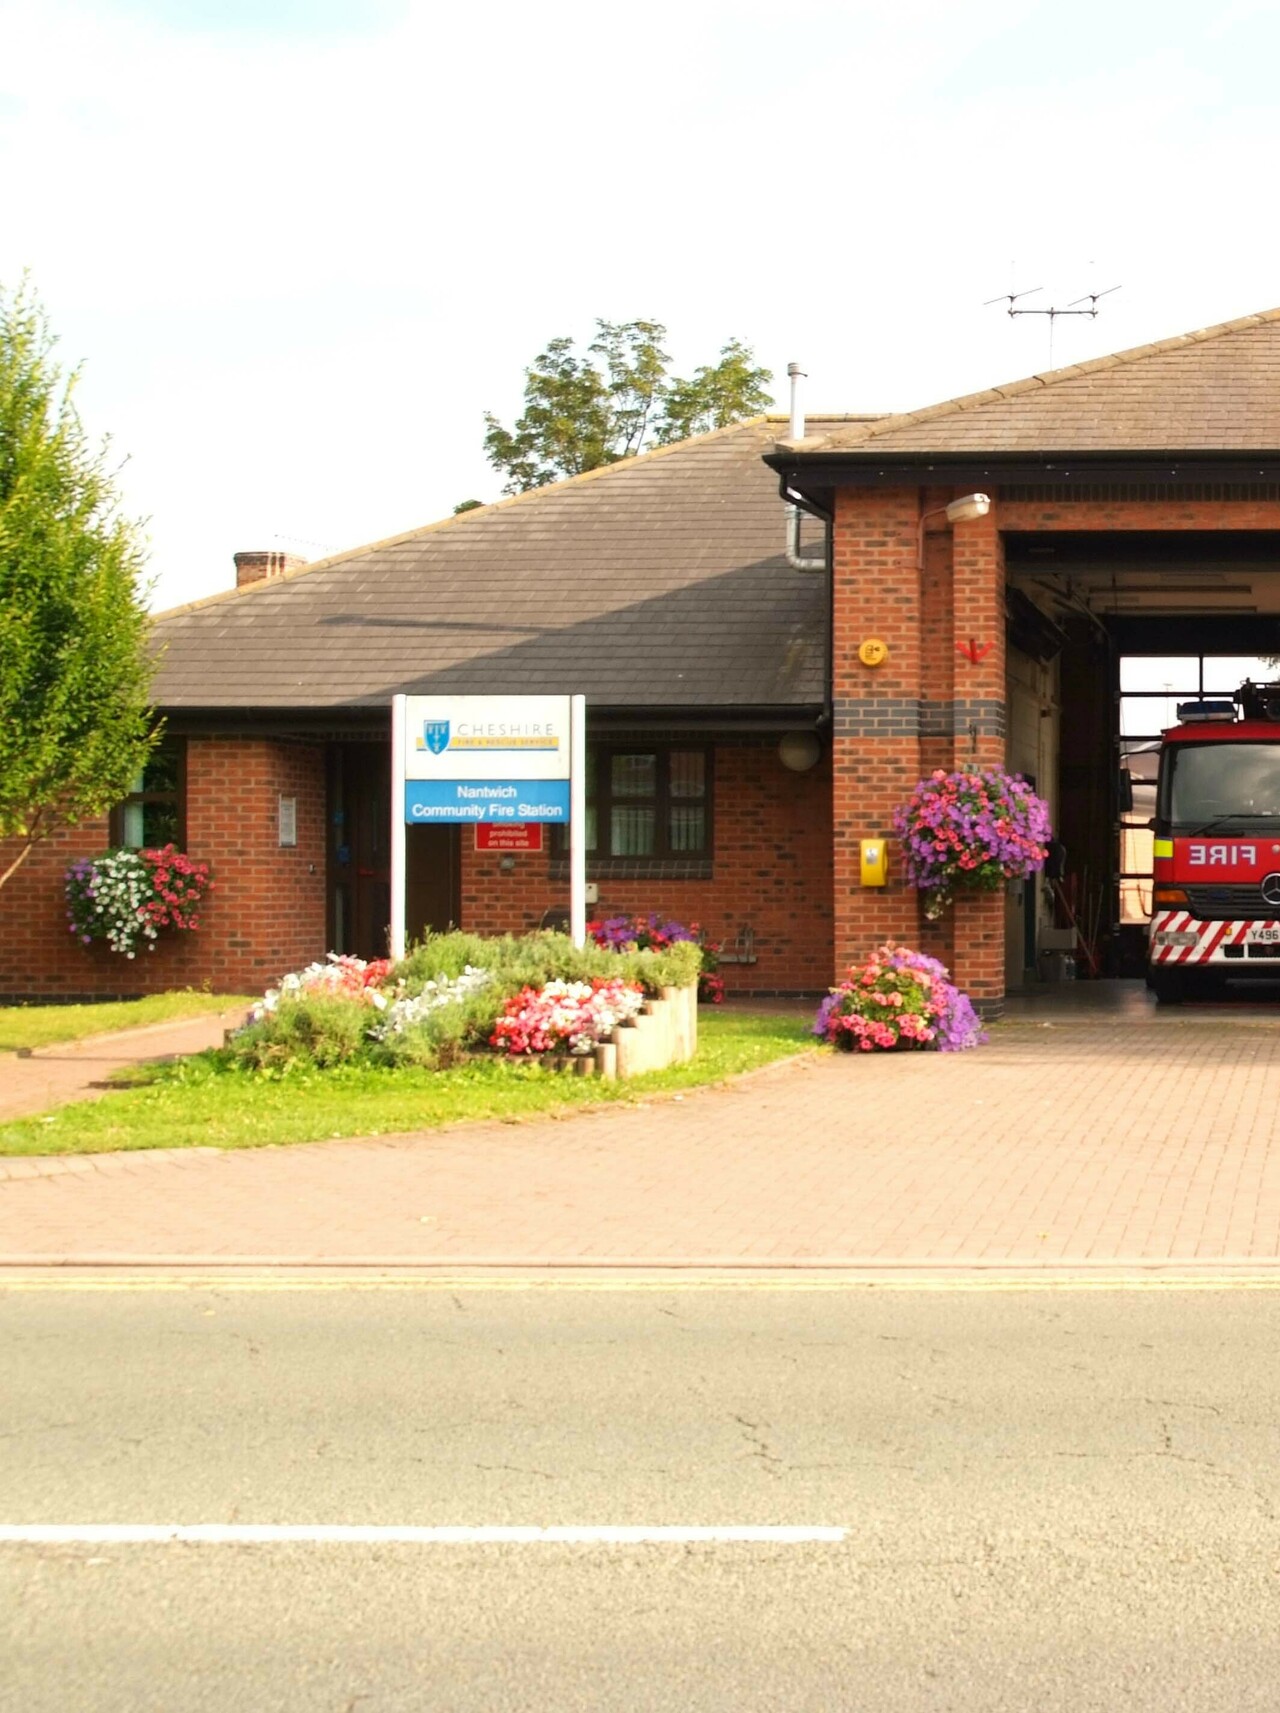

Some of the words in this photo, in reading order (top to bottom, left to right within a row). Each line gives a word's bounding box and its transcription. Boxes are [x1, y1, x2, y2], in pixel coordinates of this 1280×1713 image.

[457, 723, 553, 736] CHESHIRE
[457, 738, 475, 746] FIRE
[457, 785, 517, 798] Nantwich
[412, 804, 486, 819] Community
[489, 804, 514, 817] Fire
[518, 804, 562, 817] Station
[489, 830, 528, 838] prohibited
[1251, 930, 1279, 940] Y496
